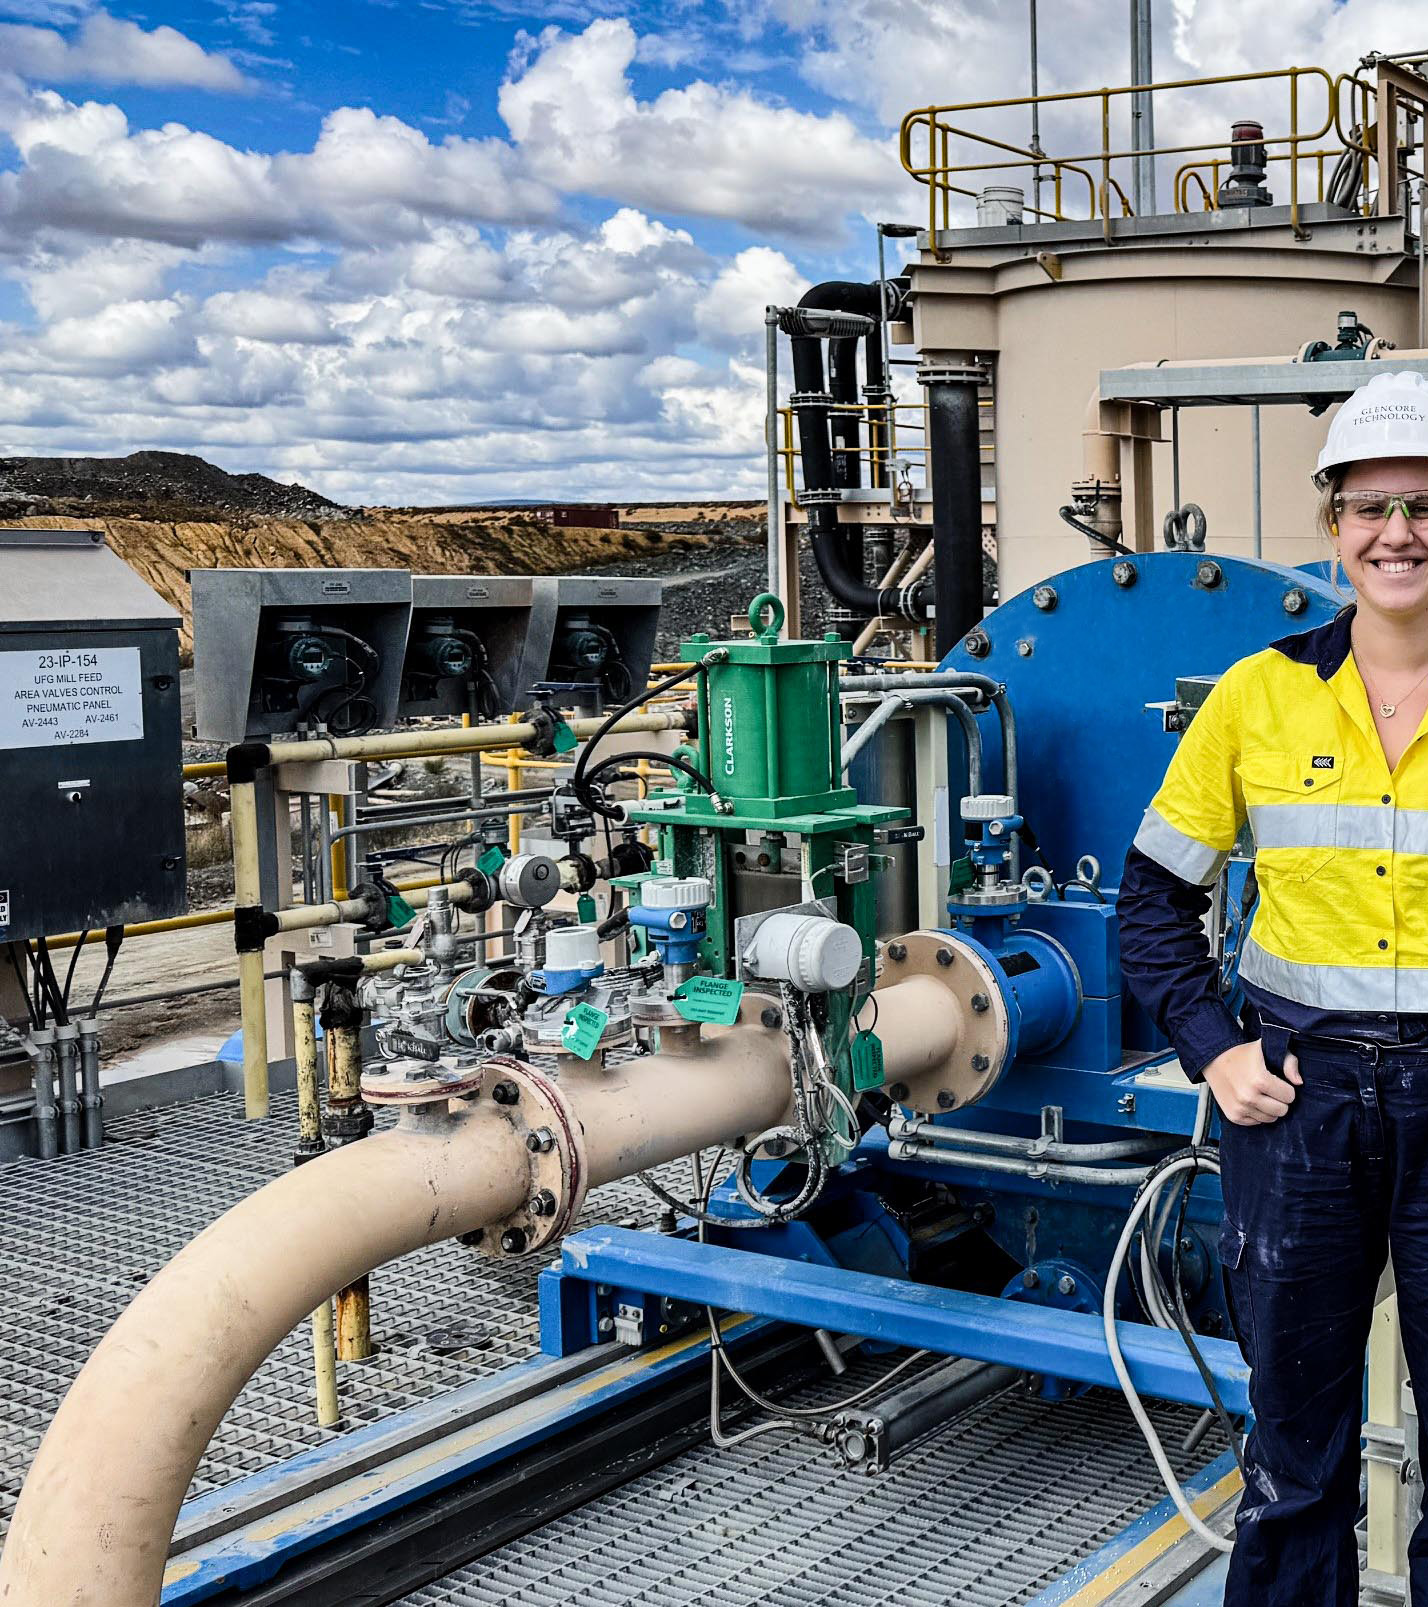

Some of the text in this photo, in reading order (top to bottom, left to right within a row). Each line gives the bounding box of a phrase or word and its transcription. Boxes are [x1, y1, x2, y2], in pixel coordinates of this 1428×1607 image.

[1361, 405, 1416, 415] GLENCORE
[1353, 413, 1425, 425] TECHNOLOGY
[39, 654, 98, 668] 23-IP-154
[34, 673, 102, 684] UFG MILL FEED
[14, 686, 123, 699] AREA VALVES CONTROL
[27, 700, 111, 712] PNEUMATIC PANEL
[22, 713, 119, 728] AV-2443 AV-2461
[724, 697, 734, 775] CLARKSON
[700, 980, 728, 989] FLANGE
[693, 986, 732, 997] INSPECTED
